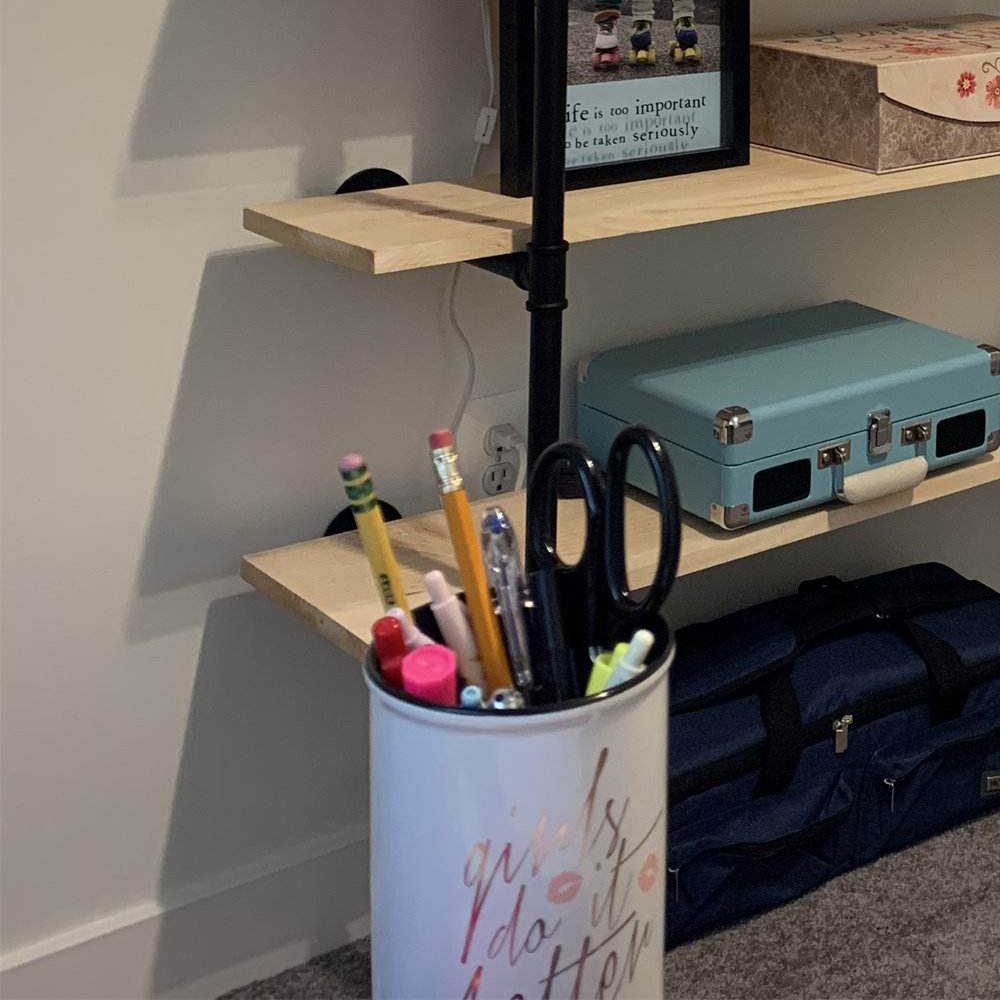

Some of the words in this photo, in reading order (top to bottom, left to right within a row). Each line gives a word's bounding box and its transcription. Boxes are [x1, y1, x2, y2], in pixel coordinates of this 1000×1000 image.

[566, 102, 589, 123] ife
[594, 107, 603, 119] is
[610, 107, 629, 116] too
[635, 96, 706, 116] important
[575, 138, 589, 149] be
[593, 134, 626, 147] taken
[633, 122, 699, 142] seriously
[463, 747, 630, 964] girls
[488, 883, 562, 967] do
[591, 808, 664, 932] it
